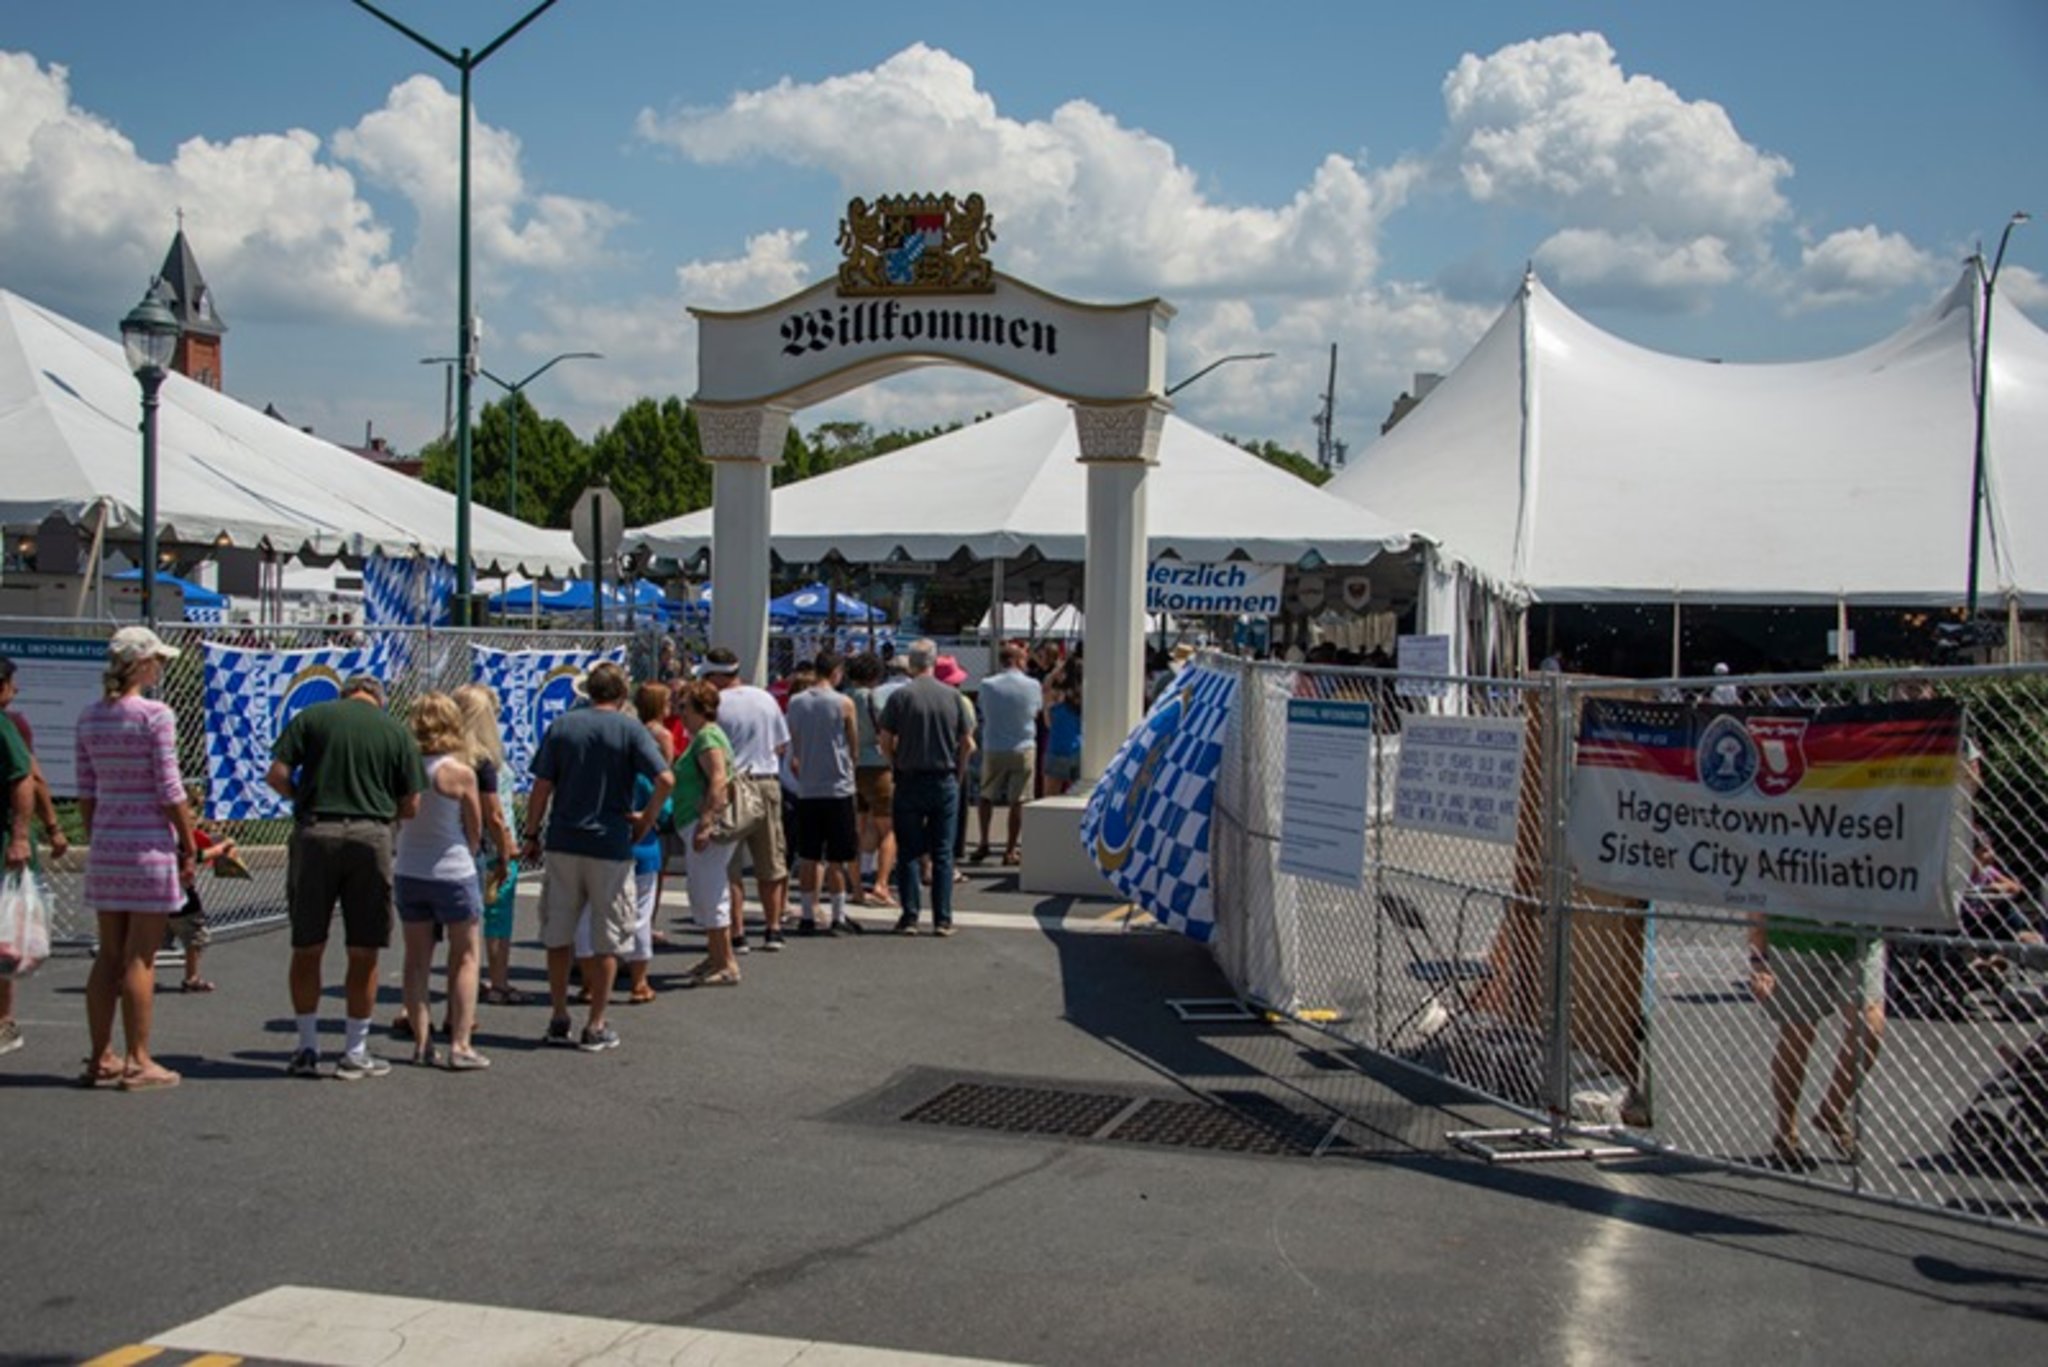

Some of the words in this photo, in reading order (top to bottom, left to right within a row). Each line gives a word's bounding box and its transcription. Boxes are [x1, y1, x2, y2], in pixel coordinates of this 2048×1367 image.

[780, 300, 1057, 356] Willkommen
[1147, 587, 1278, 613] lkommen
[0, 642, 24, 654] RAL
[27, 643, 105, 656] INFORMATIO
[1598, 832, 1678, 870] Sister
[1688, 841, 1750, 887] City
[1758, 848, 1919, 892] Affiliation
